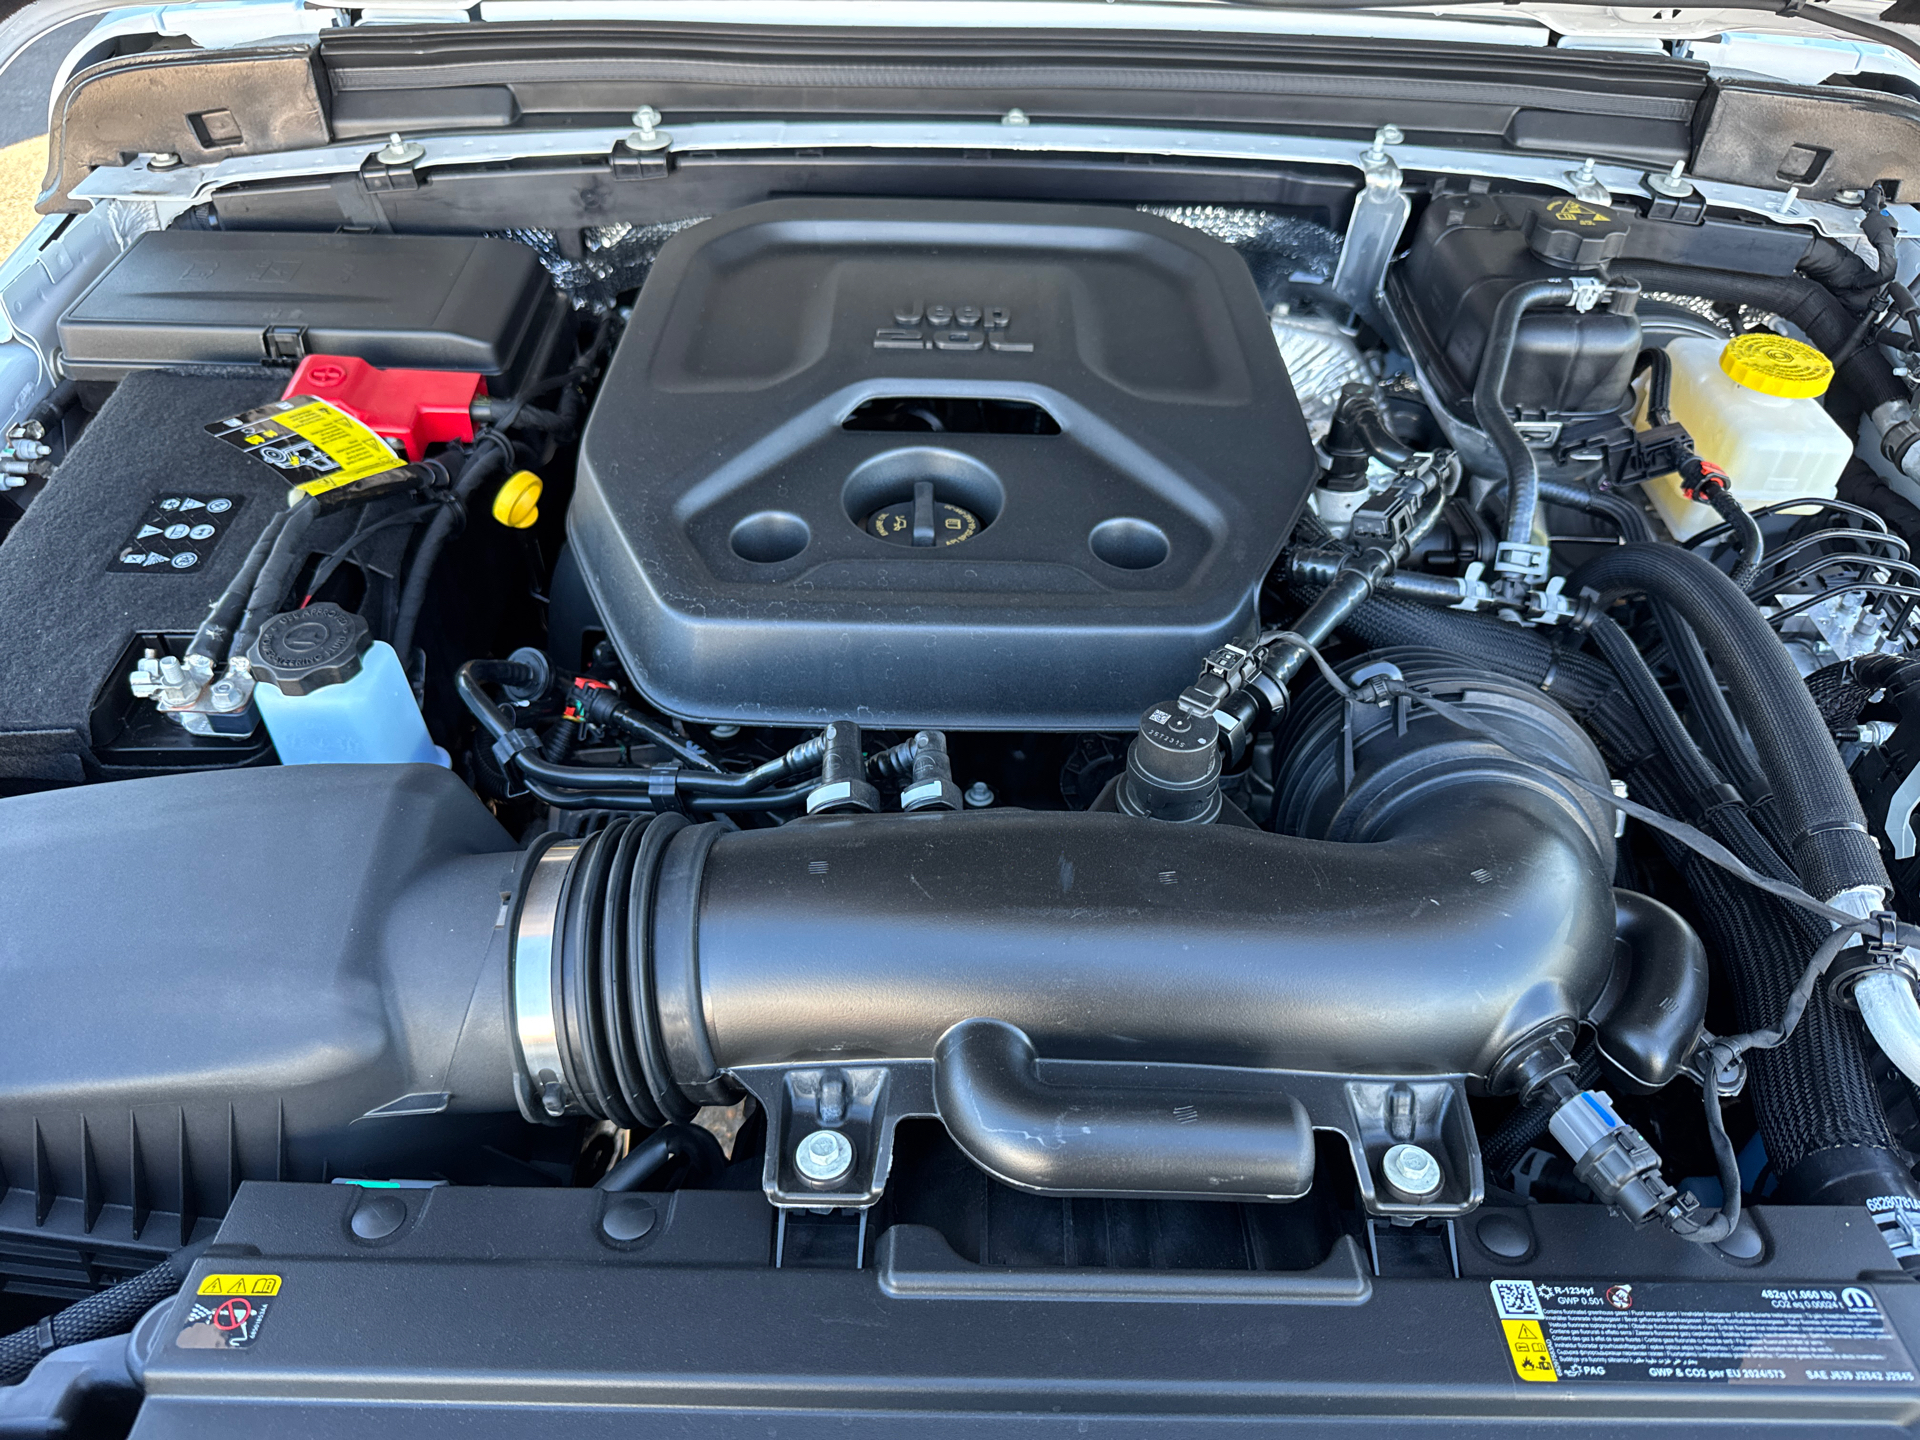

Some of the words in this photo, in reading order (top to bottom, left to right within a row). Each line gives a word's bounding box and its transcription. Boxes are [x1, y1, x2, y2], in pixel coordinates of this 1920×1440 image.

[894, 300, 1011, 331] Jeep
[873, 328, 1034, 352] 2.0L
[279, 612, 301, 625] USE
[302, 608, 348, 626] APPROVED
[273, 653, 322, 667] STEERING
[1557, 1296, 1579, 1305] GWP
[1581, 1297, 1604, 1306] 0.501
[1761, 1289, 1788, 1301] 482g
[1788, 1289, 1820, 1301] (1.060
[1820, 1290, 1837, 1301] lb)
[1771, 1299, 1792, 1308] CO2
[1792, 1301, 1805, 1310] eq
[1804, 1300, 1838, 1309] 0.00024
[1583, 1366, 1606, 1376] PAG
[1648, 1367, 1673, 1377] GWP
[1675, 1368, 1684, 1378] &
[1685, 1368, 1707, 1378] CO2
[1708, 1369, 1724, 1379] per
[1725, 1368, 1741, 1378] EU
[1805, 1369, 1829, 1380] SAE
